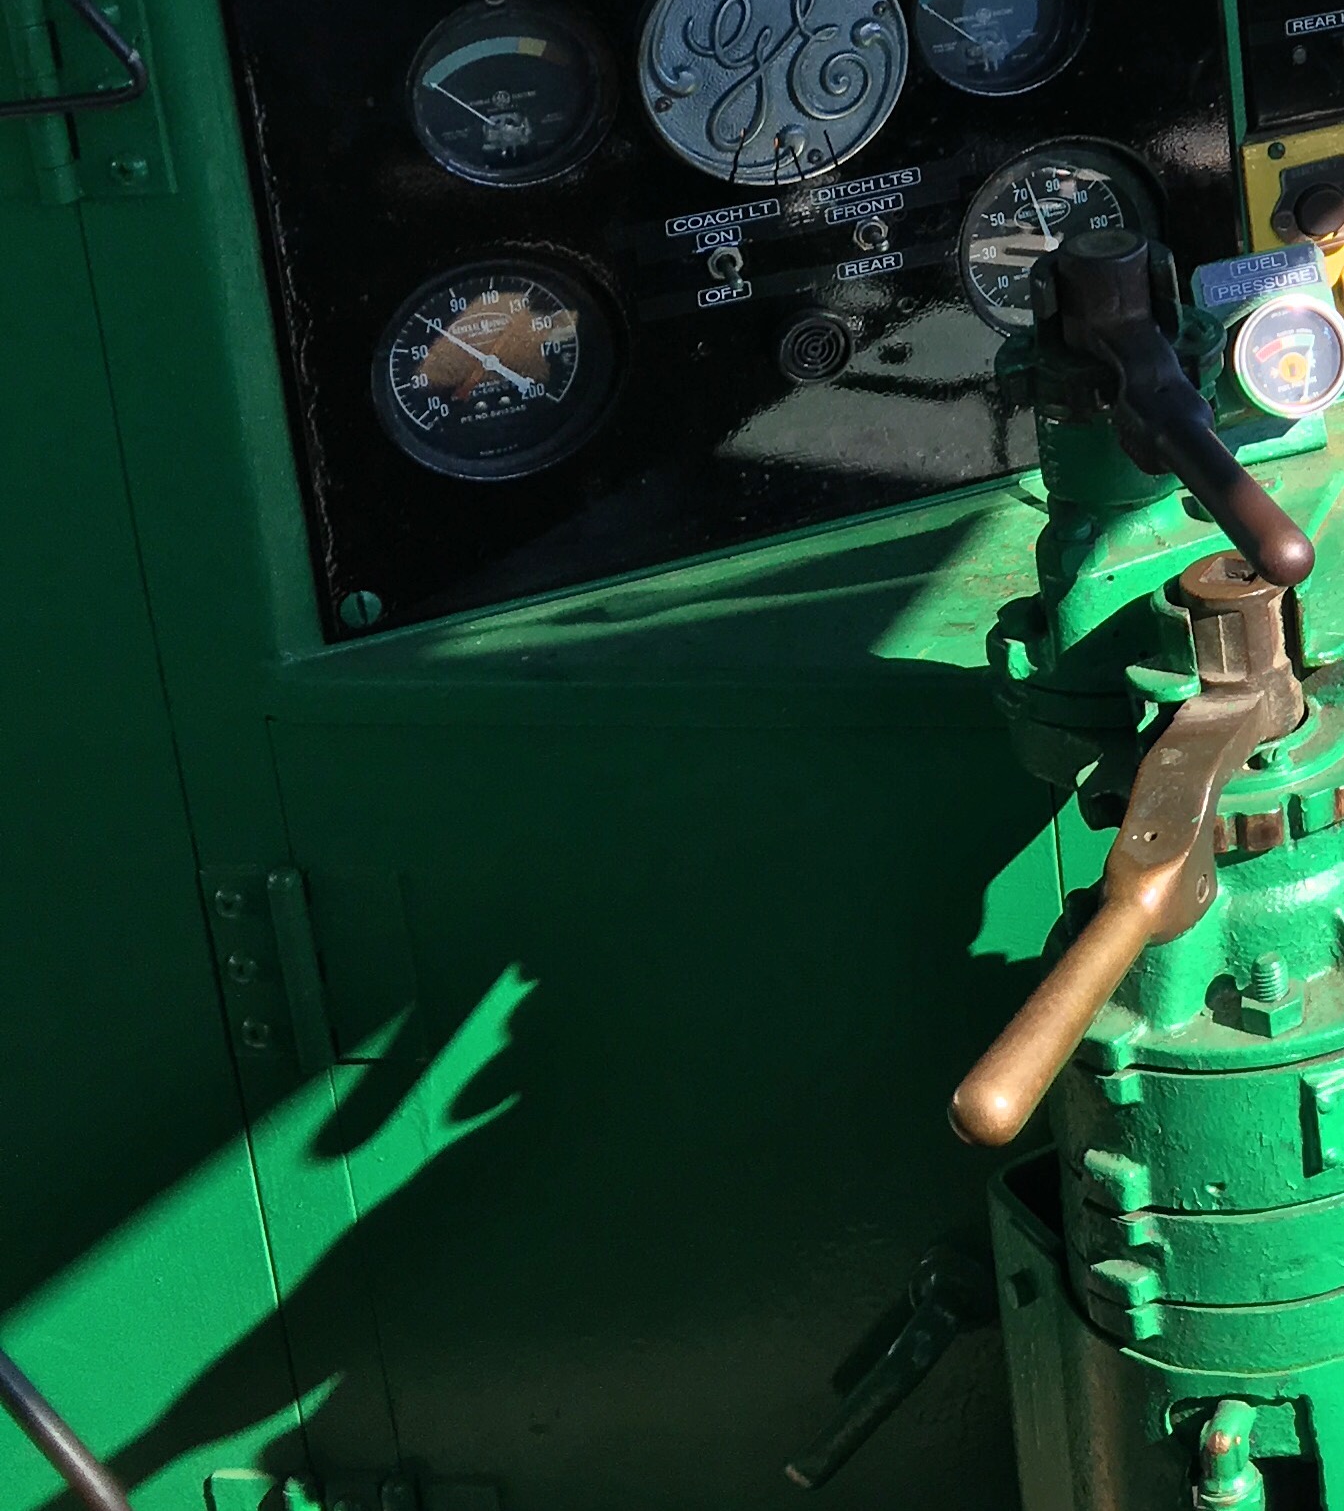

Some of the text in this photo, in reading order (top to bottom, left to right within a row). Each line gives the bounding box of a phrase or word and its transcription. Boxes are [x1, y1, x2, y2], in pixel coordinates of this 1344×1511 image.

[1292, 15, 1337, 32] REAR
[816, 171, 914, 202] DITCH LTS
[1046, 178, 1060, 192] 90
[1013, 189, 1028, 203] 70
[1073, 190, 1088, 204] 110
[832, 197, 897, 220] FRONT
[673, 201, 772, 232] COACH LT
[989, 212, 1005, 226] 50
[1090, 216, 1108, 230] 130
[704, 230, 734, 244] ON
[982, 246, 997, 260] 30
[845, 256, 895, 276] REAR
[1237, 256, 1282, 274] FUEL
[997, 275, 1009, 288] 10
[1218, 269, 1312, 298] PRESSURE
[450, 297, 467, 313] 90
[481, 290, 499, 305] 110
[509, 297, 530, 314] 130
[426, 318, 442, 333] 70
[531, 315, 552, 331] 150
[411, 345, 428, 360] 50
[540, 341, 561, 357] 170
[410, 374, 428, 389] 30
[428, 396, 440, 410] 10
[441, 403, 449, 418] 0
